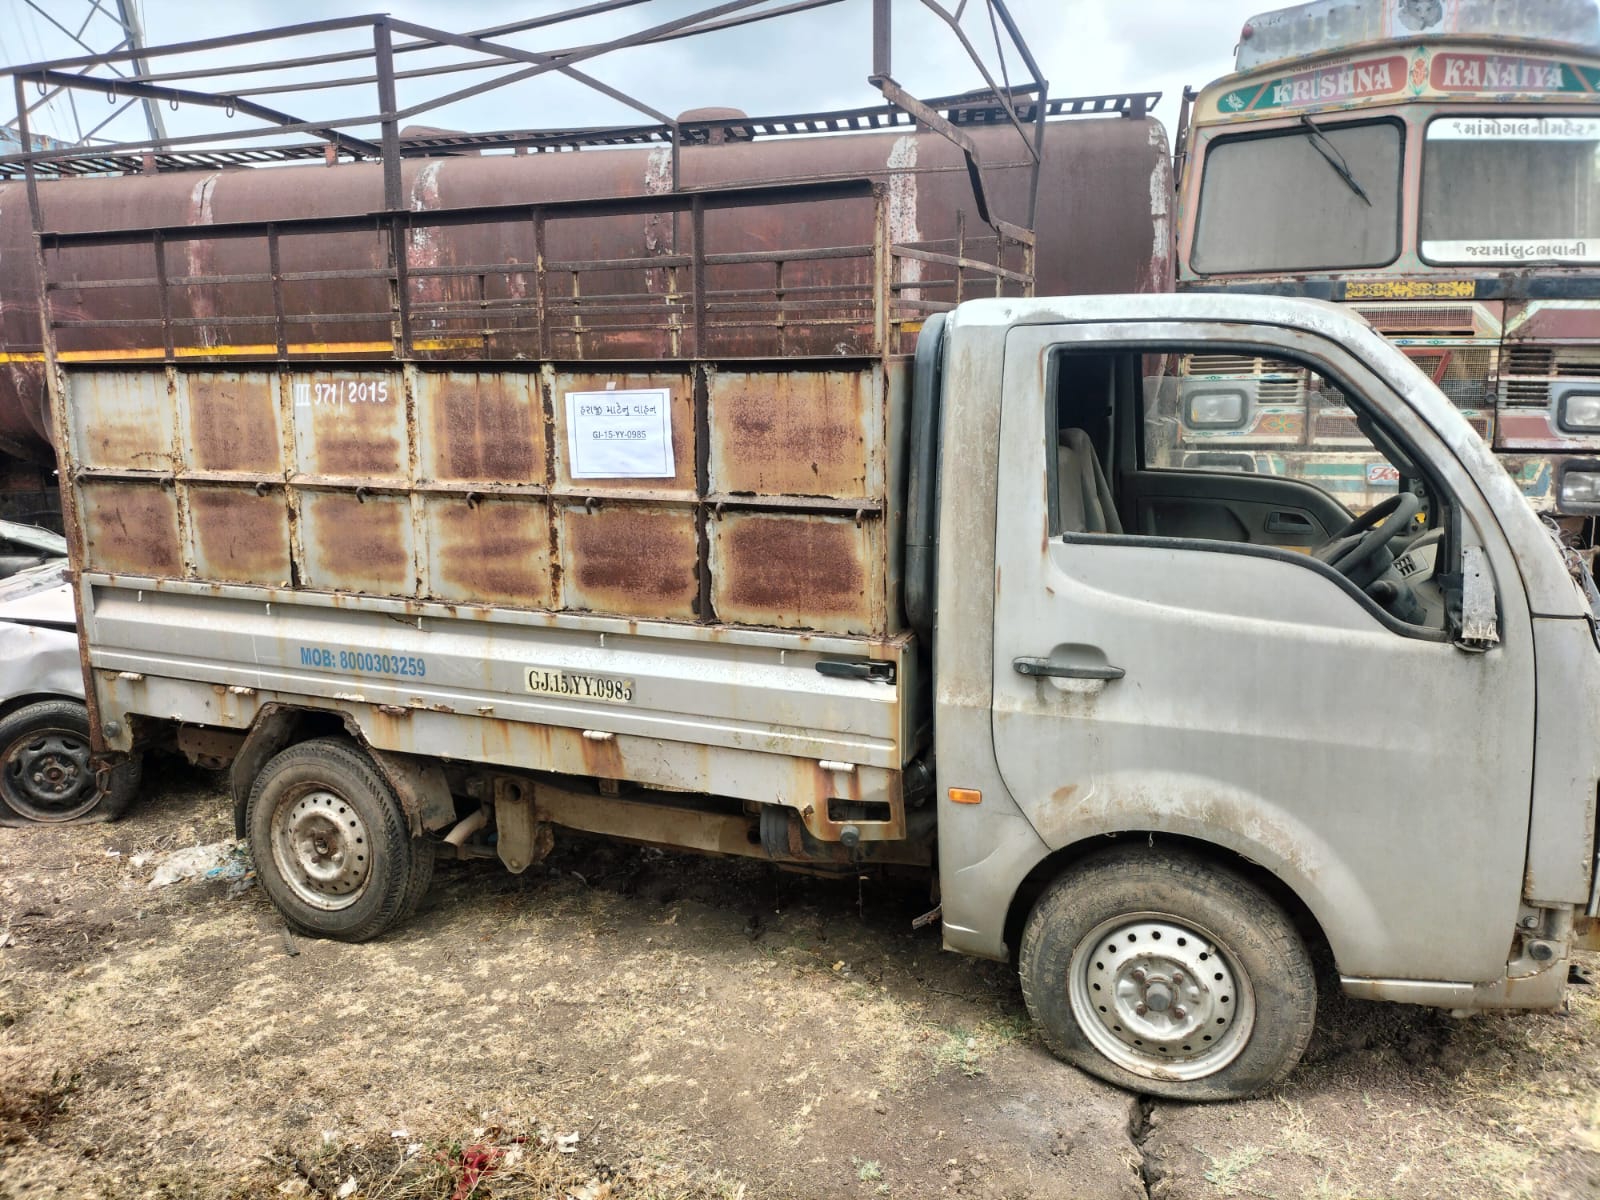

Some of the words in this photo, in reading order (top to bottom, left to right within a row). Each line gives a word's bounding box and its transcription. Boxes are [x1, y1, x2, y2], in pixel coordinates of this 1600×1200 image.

[1272, 62, 1393, 105] KRUSHNA
[1442, 57, 1565, 88] KANAIYA
[633, 404, 656, 415] વાહન
[300, 646, 336, 668] MOB:
[339, 650, 426, 677] 8000303259
